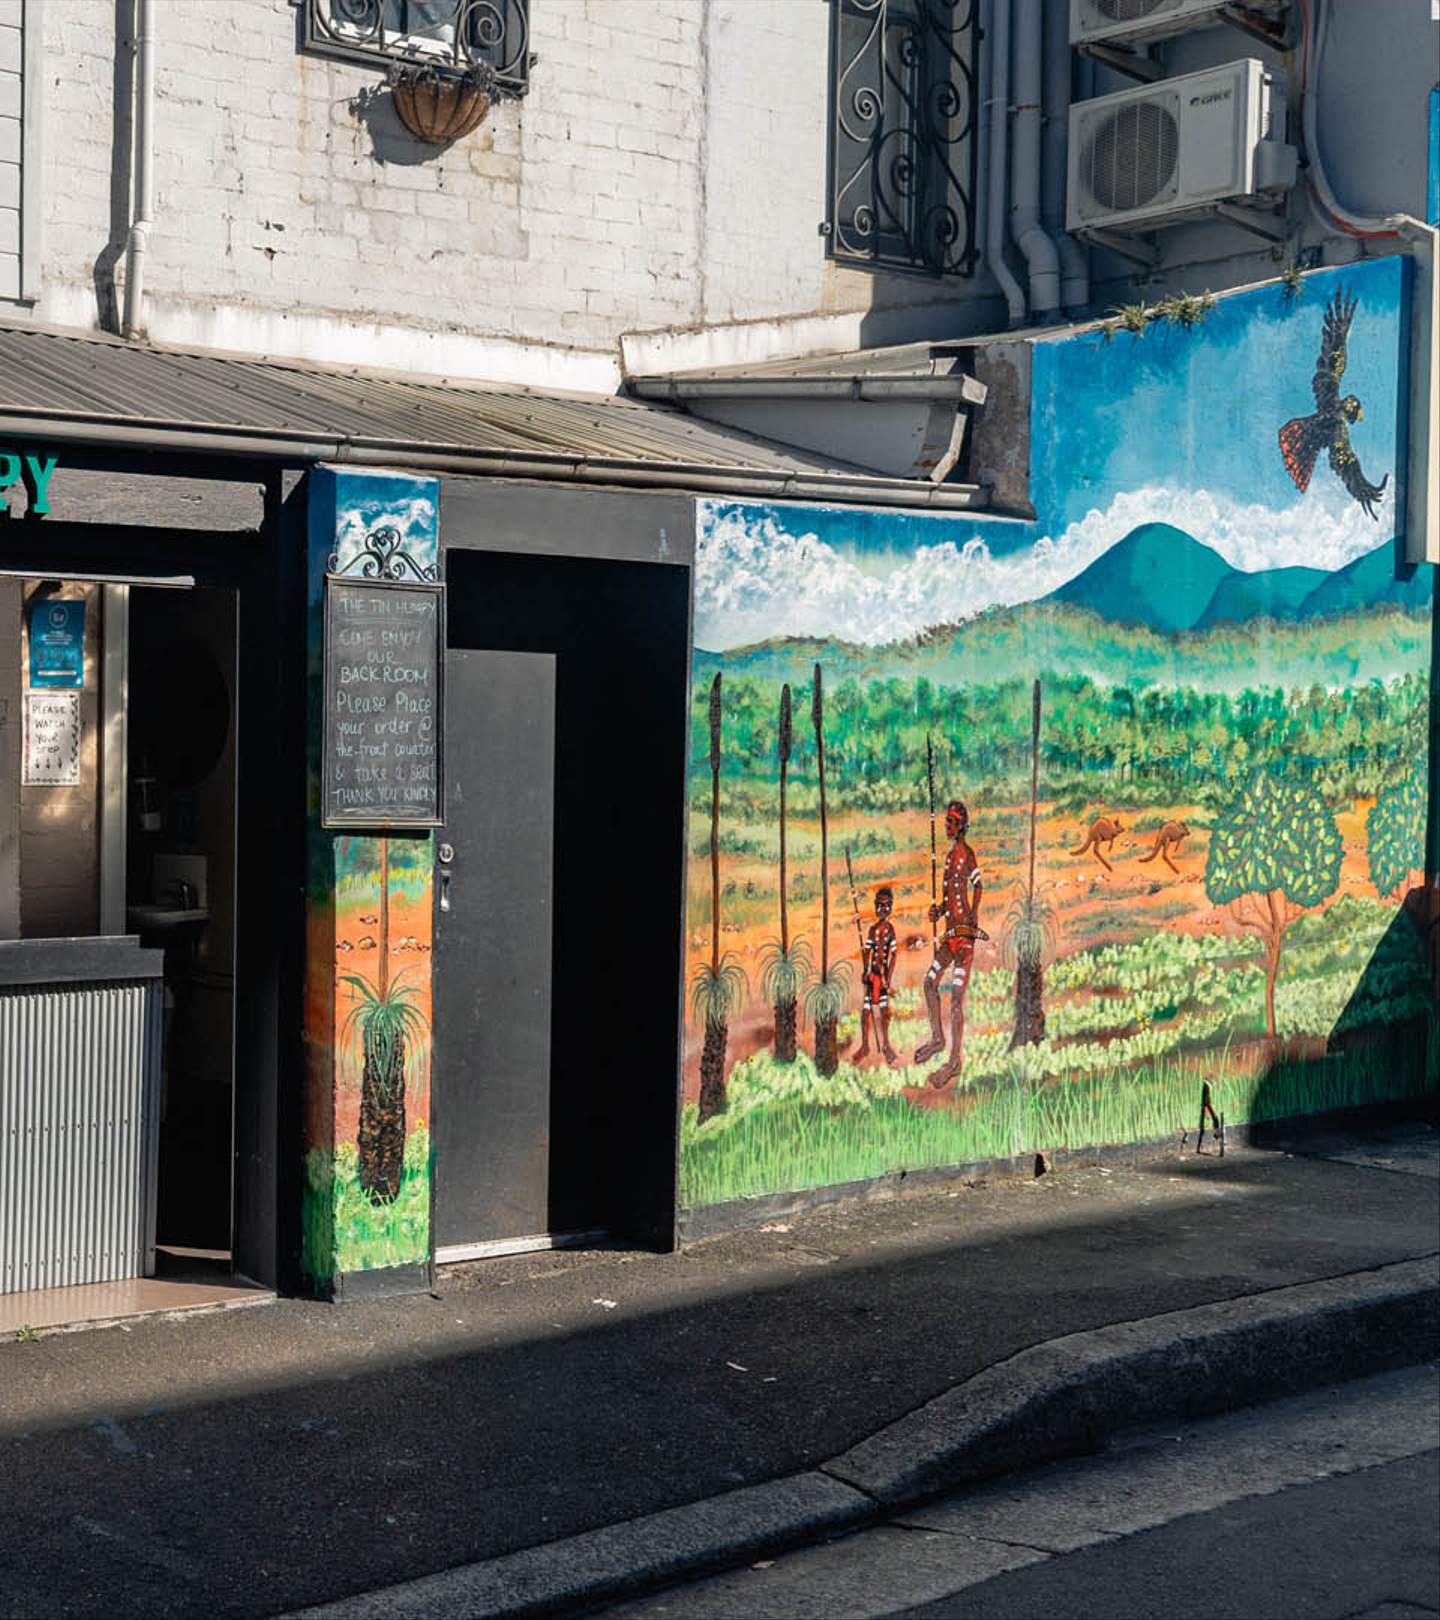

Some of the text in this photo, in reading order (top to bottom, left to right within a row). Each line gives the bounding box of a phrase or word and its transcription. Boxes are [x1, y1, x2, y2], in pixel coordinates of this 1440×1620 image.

[340, 599, 437, 618] THE TIN HUMPY
[339, 629, 375, 647] COME
[368, 648, 397, 664] OUR
[340, 665, 429, 685] BACK ROOM
[336, 690, 386, 714] Please
[336, 720, 364, 744] your
[374, 717, 414, 735] order
[335, 738, 353, 757] the
[394, 741, 437, 757] counter
[354, 765, 387, 782] take
[409, 762, 437, 780] seat
[331, 786, 374, 805] THANK
[377, 786, 398, 801] YOU
